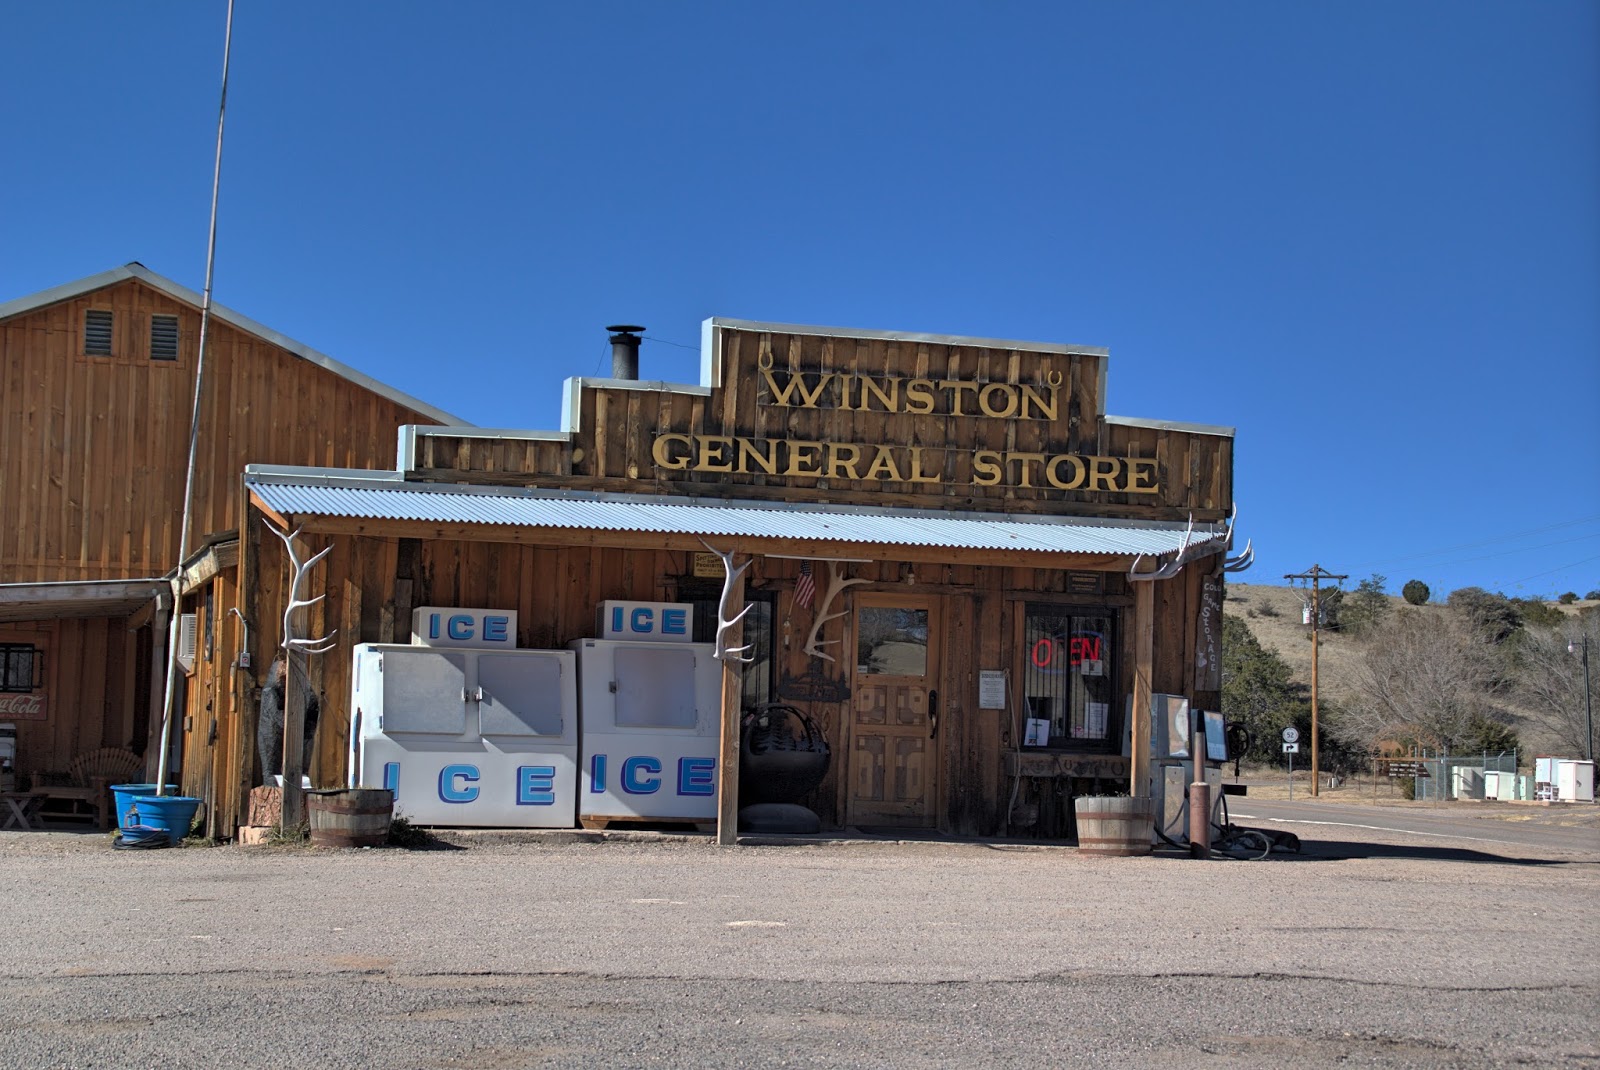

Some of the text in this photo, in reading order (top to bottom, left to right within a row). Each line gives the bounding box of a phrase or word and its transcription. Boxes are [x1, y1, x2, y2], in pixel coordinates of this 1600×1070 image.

[764, 371, 1058, 420] WINSTON
[651, 433, 1160, 494] GENERAL STORE
[429, 613, 509, 641] ICE
[611, 606, 687, 634] ICE
[0, 695, 44, 714] a-Cola
[383, 761, 556, 806] ICE
[590, 754, 717, 797] ICE
